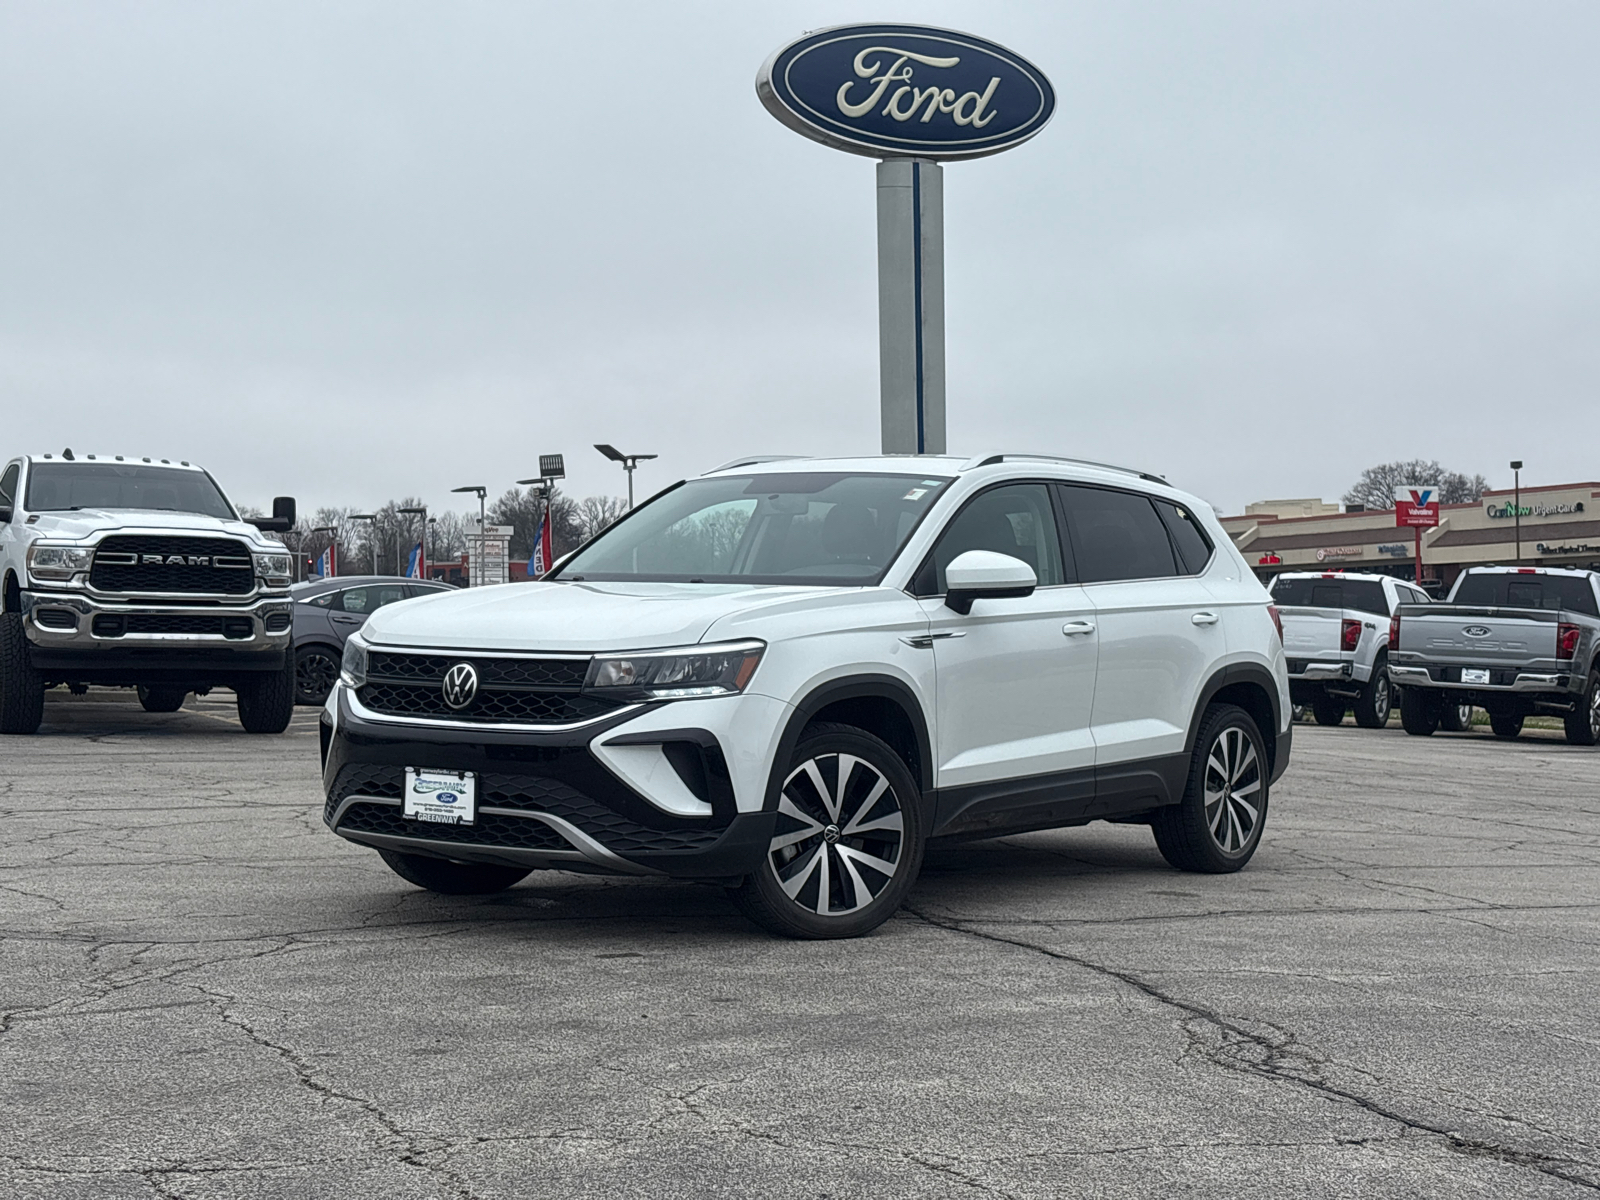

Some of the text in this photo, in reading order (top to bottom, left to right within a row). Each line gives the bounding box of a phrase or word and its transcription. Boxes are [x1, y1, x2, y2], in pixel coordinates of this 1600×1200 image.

[837, 46, 1001, 129] Ford
[1408, 508, 1433, 516] Valvoline
[1533, 505, 1557, 517] Urgent
[1558, 503, 1576, 513] Care
[142, 554, 209, 566] RAM
[439, 793, 455, 802] Ford
[417, 813, 458, 825] GREENWAY
